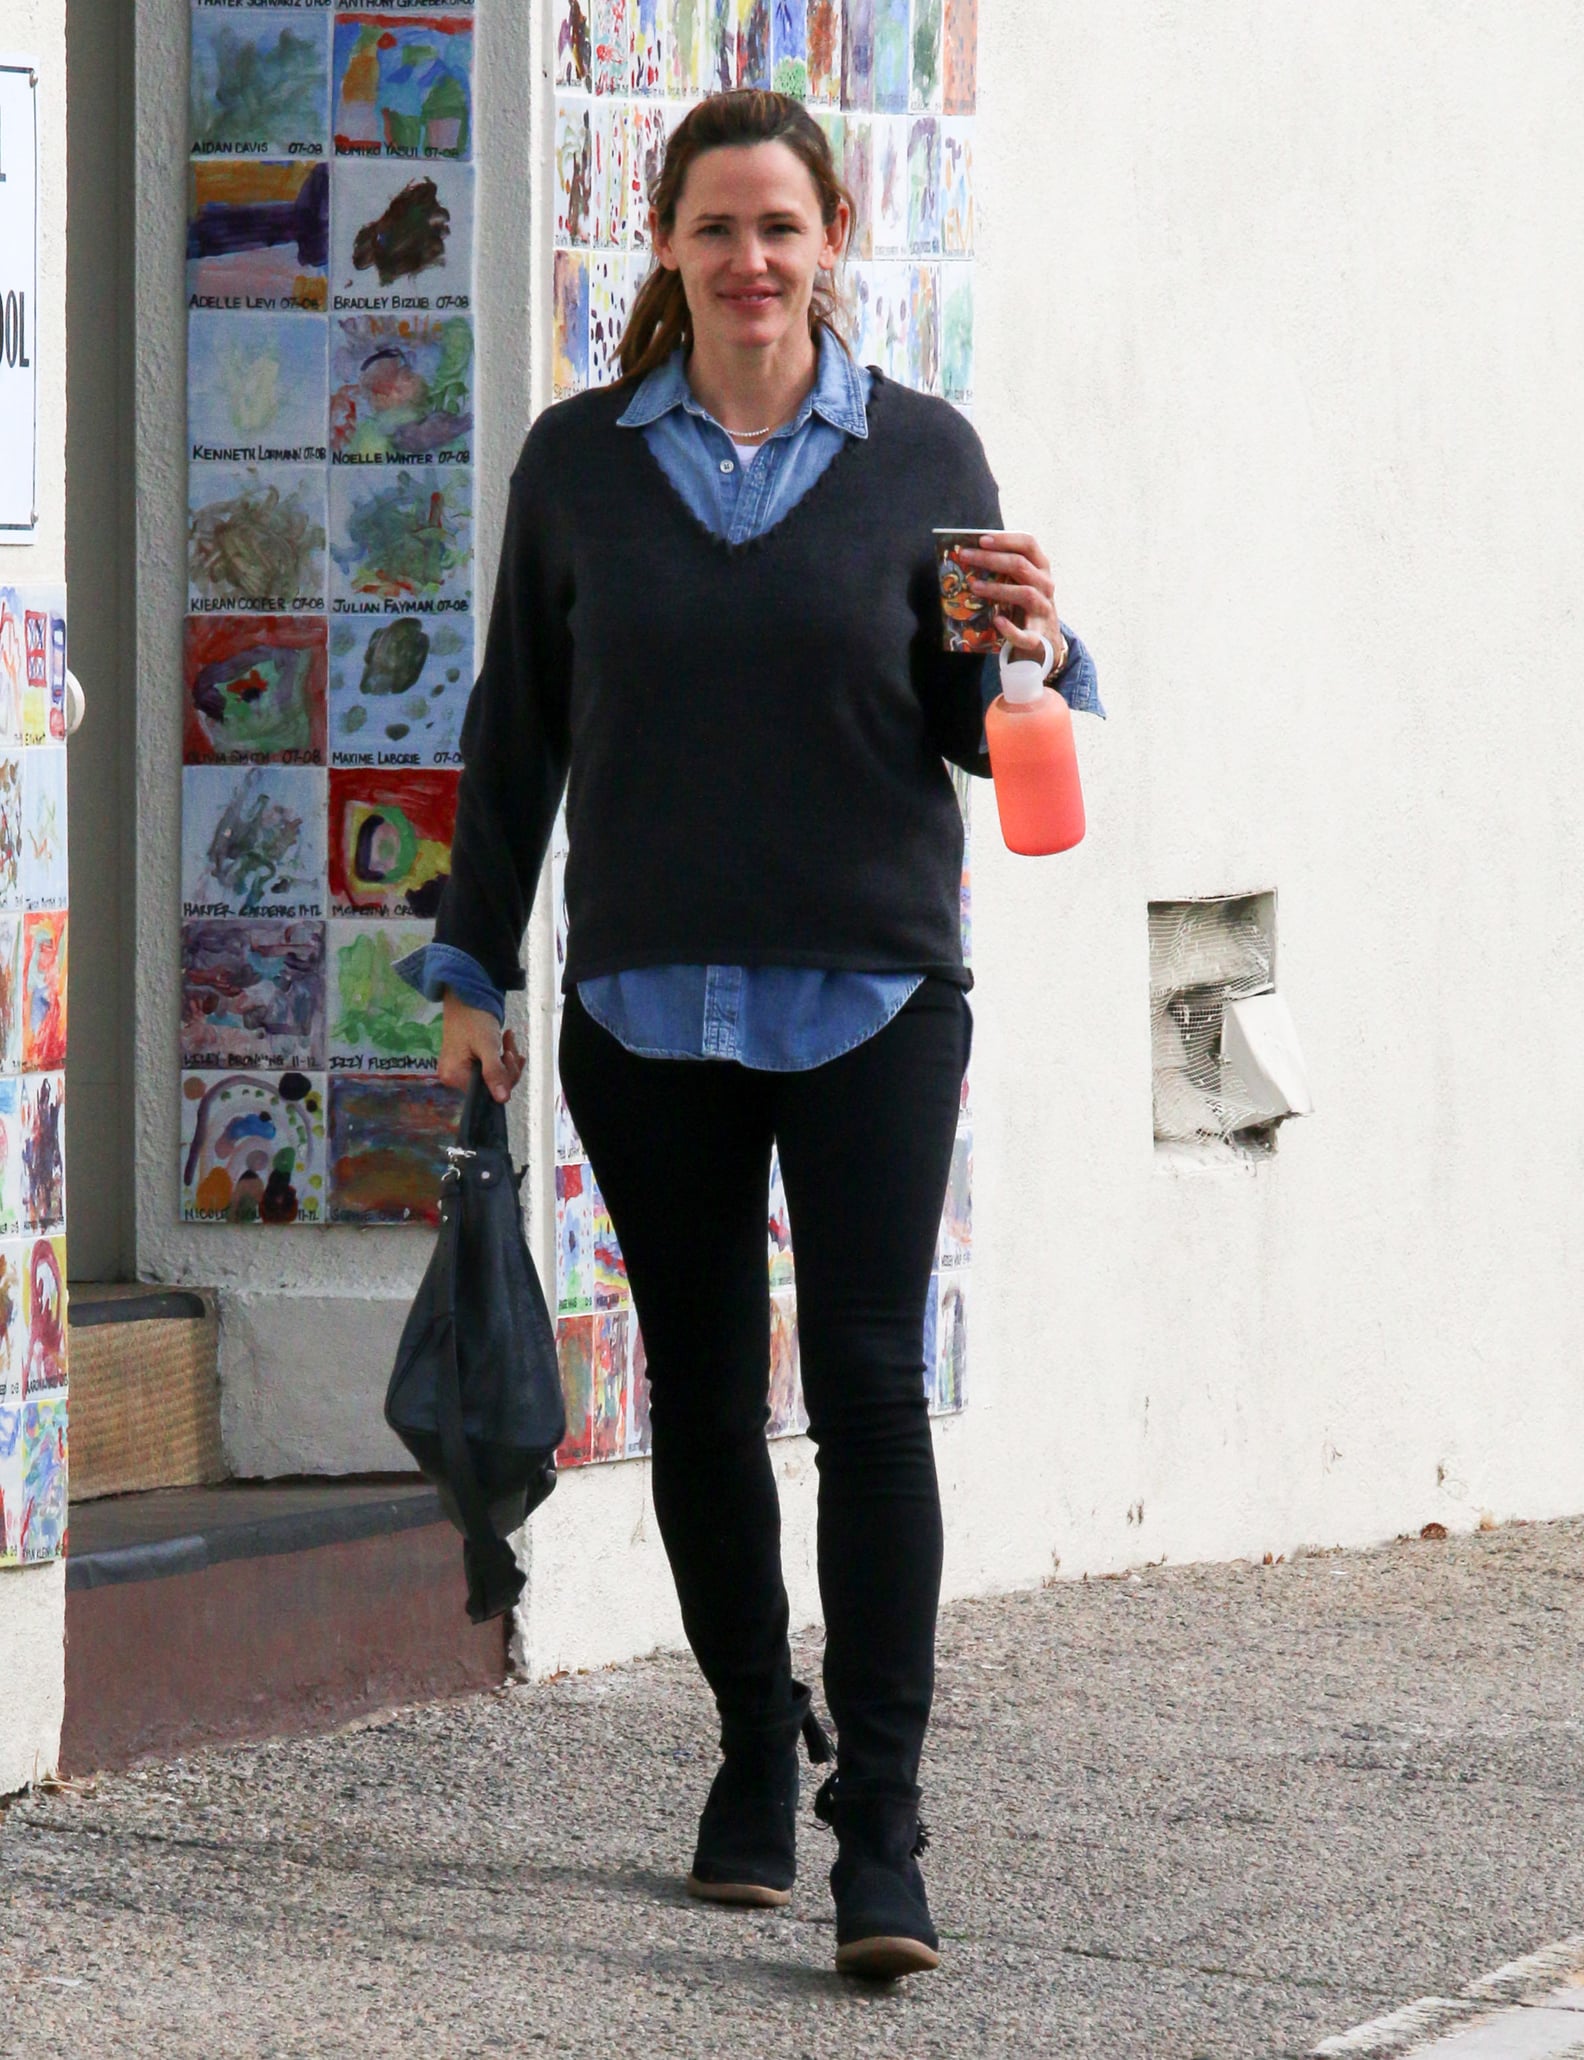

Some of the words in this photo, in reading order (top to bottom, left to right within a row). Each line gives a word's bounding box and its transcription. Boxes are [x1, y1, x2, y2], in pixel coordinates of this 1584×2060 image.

[191, 142, 233, 153] AIDAN
[235, 142, 268, 153] DAVIS
[288, 143, 323, 154] 07-08
[189, 294, 241, 309] ADELLE
[246, 296, 276, 309] LEVI
[334, 296, 389, 309] BRADLEY
[436, 296, 470, 308] 07-08
[192, 445, 256, 460] KENNETH
[303, 447, 327, 460] 07-08
[332, 451, 382, 464] NOELLE
[386, 452, 433, 464] WINTER
[438, 451, 470, 464] 07-08
[191, 598, 235, 612] KIERAN
[238, 598, 287, 611] COOPER
[291, 598, 324, 610] 07-08
[334, 598, 380, 612] JULIAN
[384, 598, 434, 613] FAYMAN
[436, 599, 469, 612] 07-08
[282, 749, 322, 763] 07-08
[332, 752, 375, 764] MAXIME
[433, 752, 463, 764] 07-0
[184, 902, 236, 917] HARPER
[292, 1055, 318, 1067] 11-12
[330, 1055, 364, 1069] IZZY
[298, 1209, 320, 1220] 11-12
